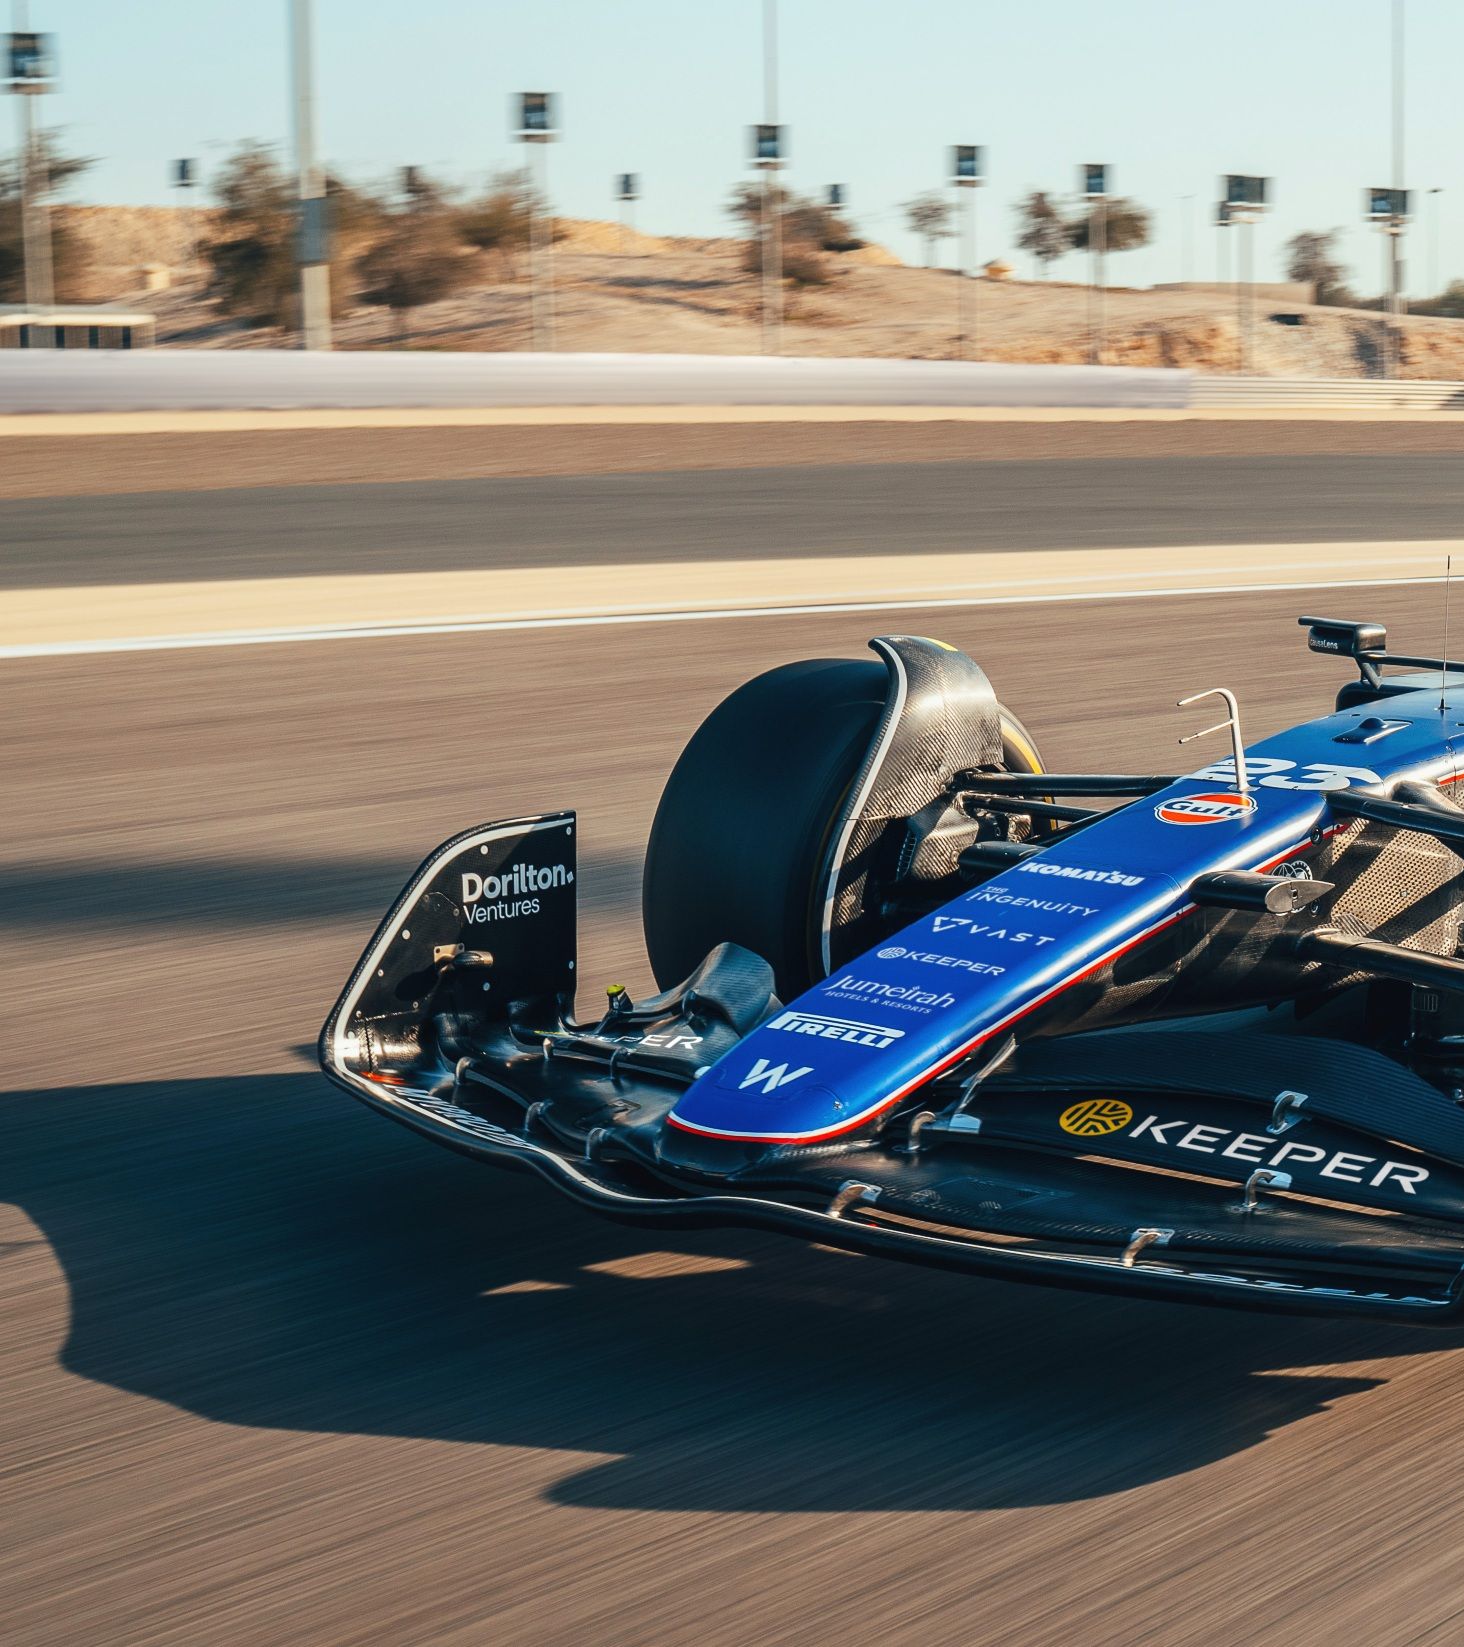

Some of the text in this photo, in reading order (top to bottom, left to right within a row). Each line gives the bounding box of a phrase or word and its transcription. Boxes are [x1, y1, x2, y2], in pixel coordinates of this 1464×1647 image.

[1163, 800, 1248, 817] Gulf
[461, 863, 566, 903] Dorilton
[1018, 862, 1146, 887] KOMATSU
[462, 898, 541, 925] Ventures
[968, 923, 1056, 947] VAST
[903, 950, 1006, 977] KEEPER
[821, 975, 957, 1009] Jumeirah
[825, 989, 870, 1003] HOTELS
[882, 999, 933, 1015] RESORTS
[766, 1011, 906, 1050] PIRELLI
[1127, 1114, 1431, 1196] KEEPER
